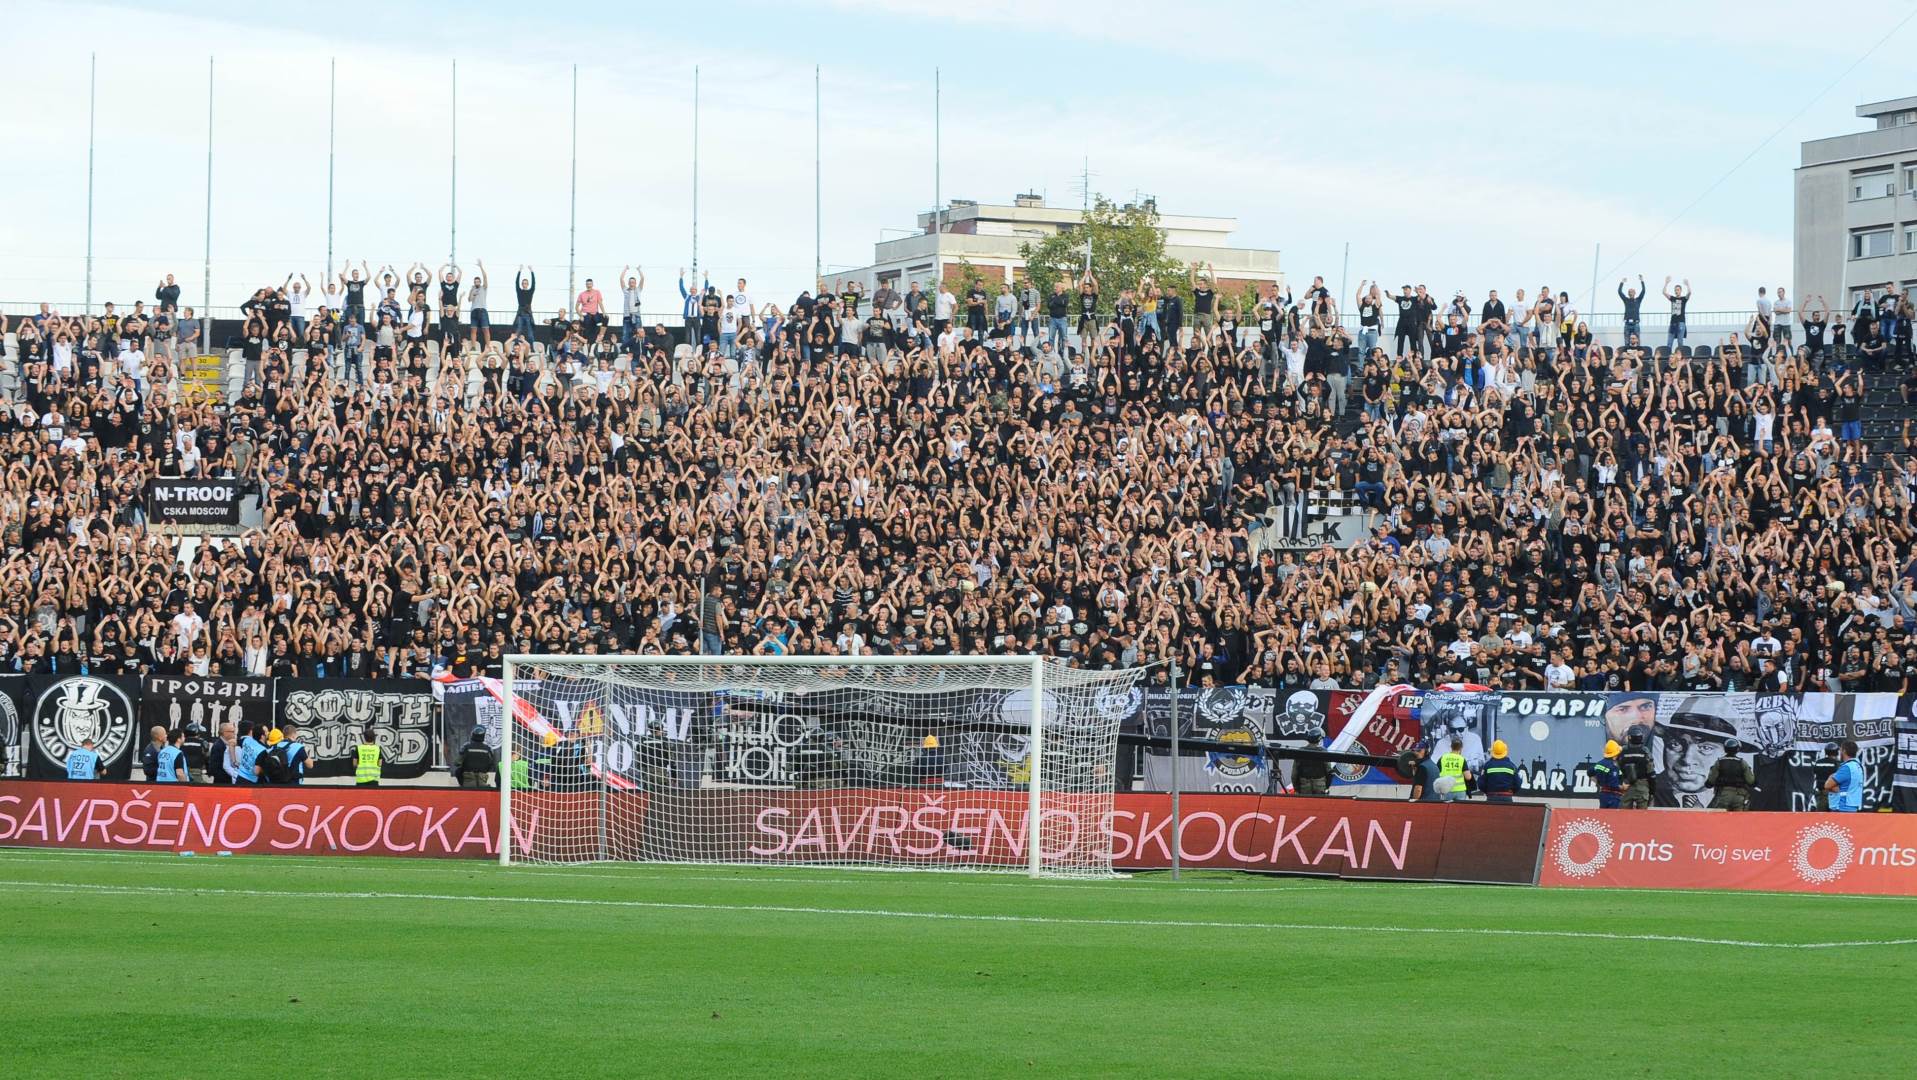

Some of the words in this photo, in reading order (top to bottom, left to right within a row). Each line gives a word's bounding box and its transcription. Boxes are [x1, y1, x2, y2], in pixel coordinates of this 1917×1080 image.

[163, 507, 188, 516] CSKA
[189, 507, 229, 516] MOSCOW
[151, 678, 266, 698] ГРОБАРИ
[285, 688, 434, 728] SOUTH
[1500, 697, 1606, 717] РОБАРИ
[1796, 722, 1848, 739] НОВИ
[1853, 718, 1893, 737] САД
[296, 723, 429, 764] GUARD
[0, 790, 262, 849] SAVRŠENO
[270, 804, 539, 855] SKOCKAN
[749, 794, 1080, 859] SAVRŠENO
[1092, 810, 1413, 871] SKOCKAN
[1618, 839, 1674, 862] mts
[1691, 843, 1728, 864] Tvoj
[1731, 846, 1772, 862] svet
[1859, 842, 1917, 867] mts
